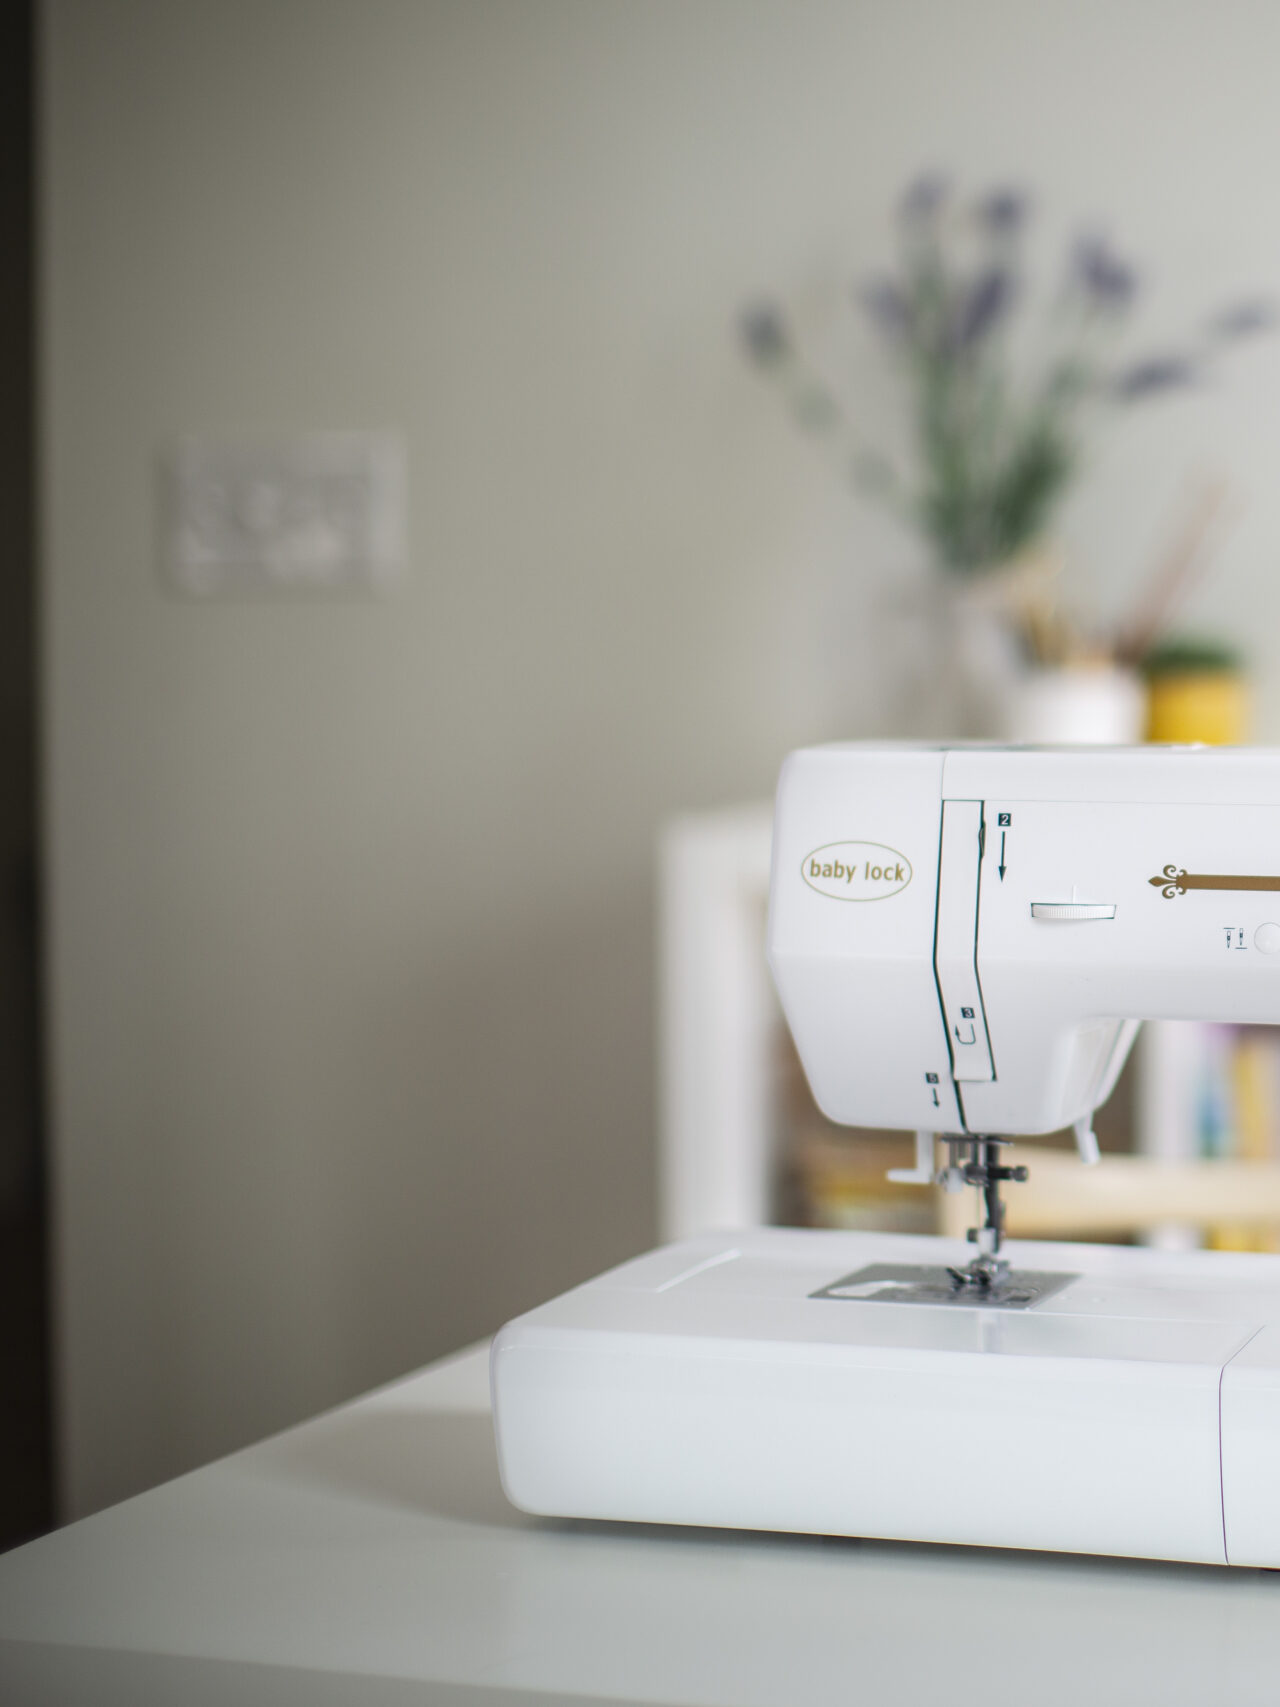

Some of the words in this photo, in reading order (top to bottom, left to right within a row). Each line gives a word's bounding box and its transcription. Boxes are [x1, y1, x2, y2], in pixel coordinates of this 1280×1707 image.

[1000, 814, 1010, 825] 2
[810, 858, 857, 884] baby
[865, 861, 905, 882] lock
[963, 1007, 973, 1018] 3
